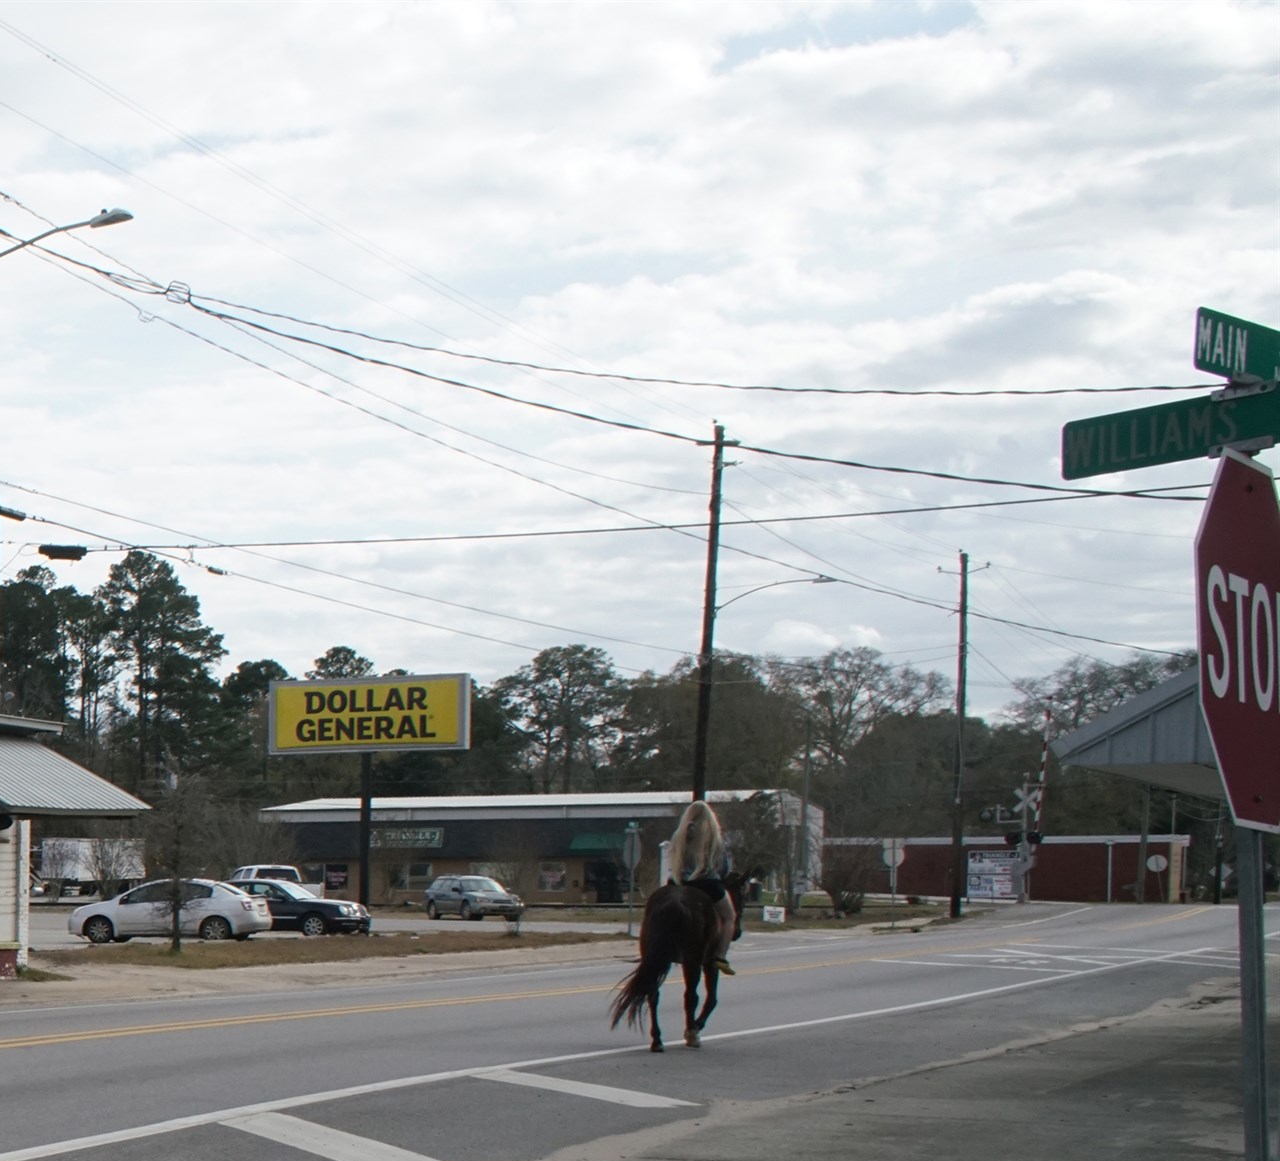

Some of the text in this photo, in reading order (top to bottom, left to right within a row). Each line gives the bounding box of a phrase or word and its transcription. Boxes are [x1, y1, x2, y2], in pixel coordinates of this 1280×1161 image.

[1197, 315, 1247, 374] MAIN
[1068, 400, 1239, 470] WILLIAMS
[304, 686, 428, 715] DOLLAR
[295, 714, 437, 743] GENERAL
